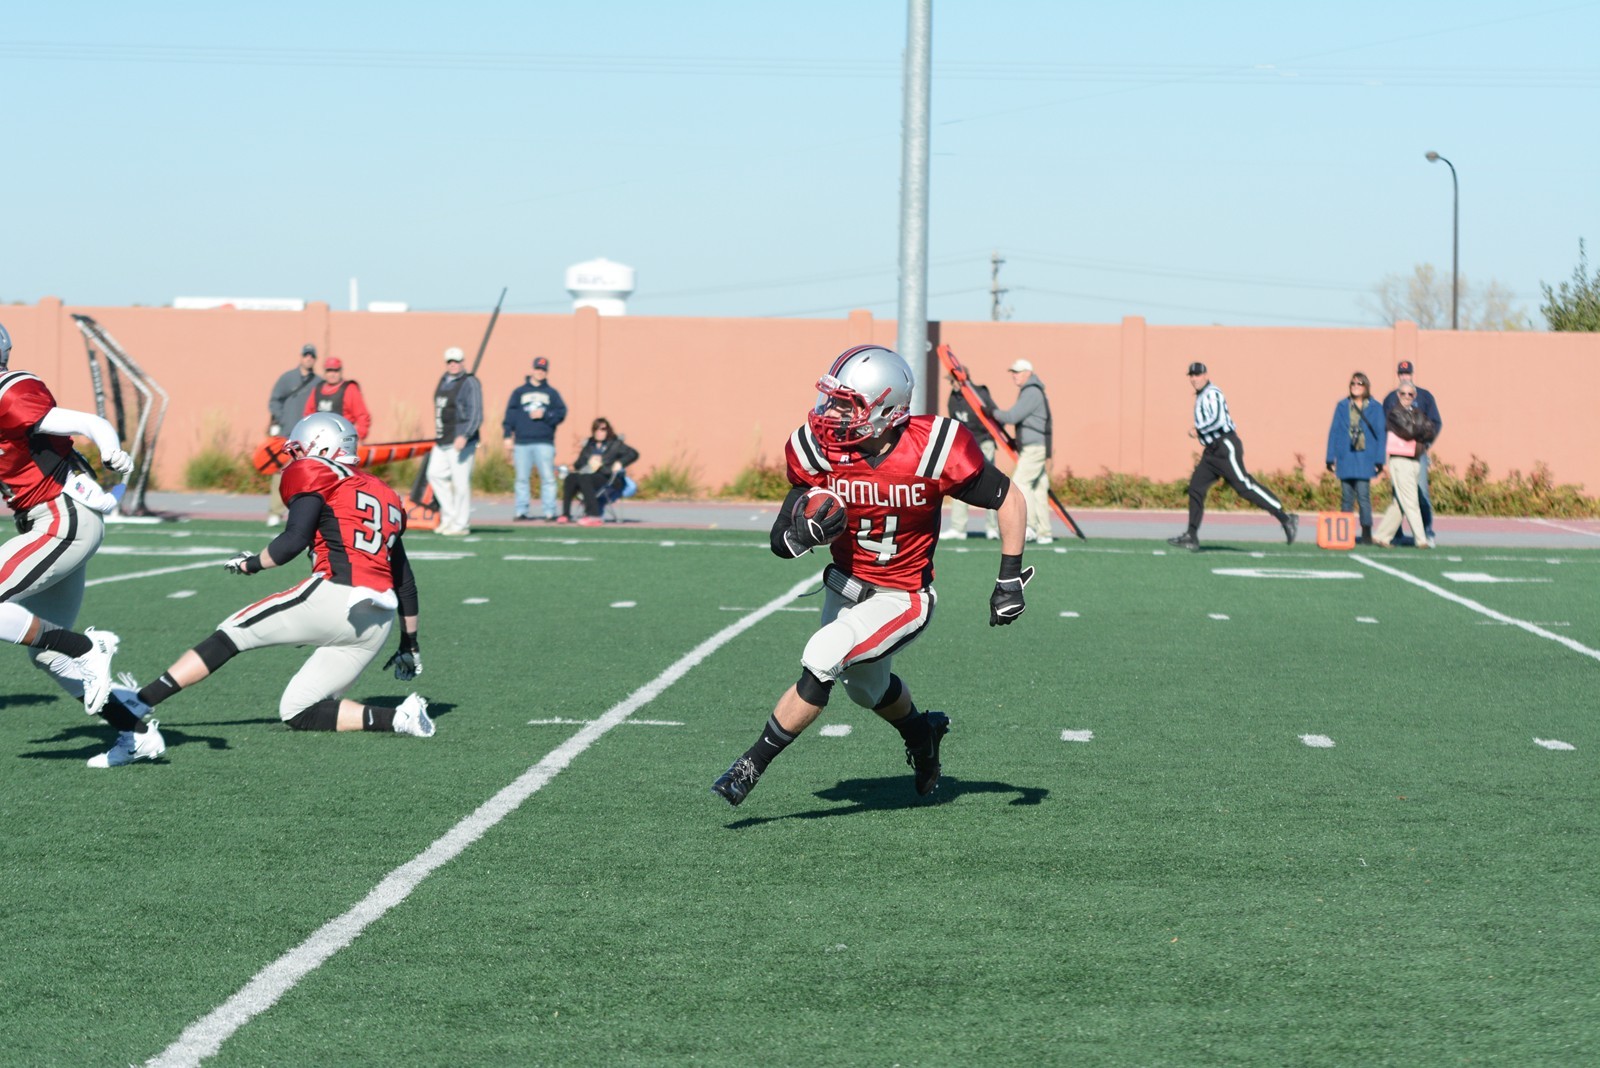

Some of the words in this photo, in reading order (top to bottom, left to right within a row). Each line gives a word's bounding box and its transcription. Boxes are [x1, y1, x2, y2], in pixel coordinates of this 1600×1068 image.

[827, 474, 927, 507] HAMLINE
[856, 514, 899, 566] 4
[1324, 517, 1349, 542] 10
